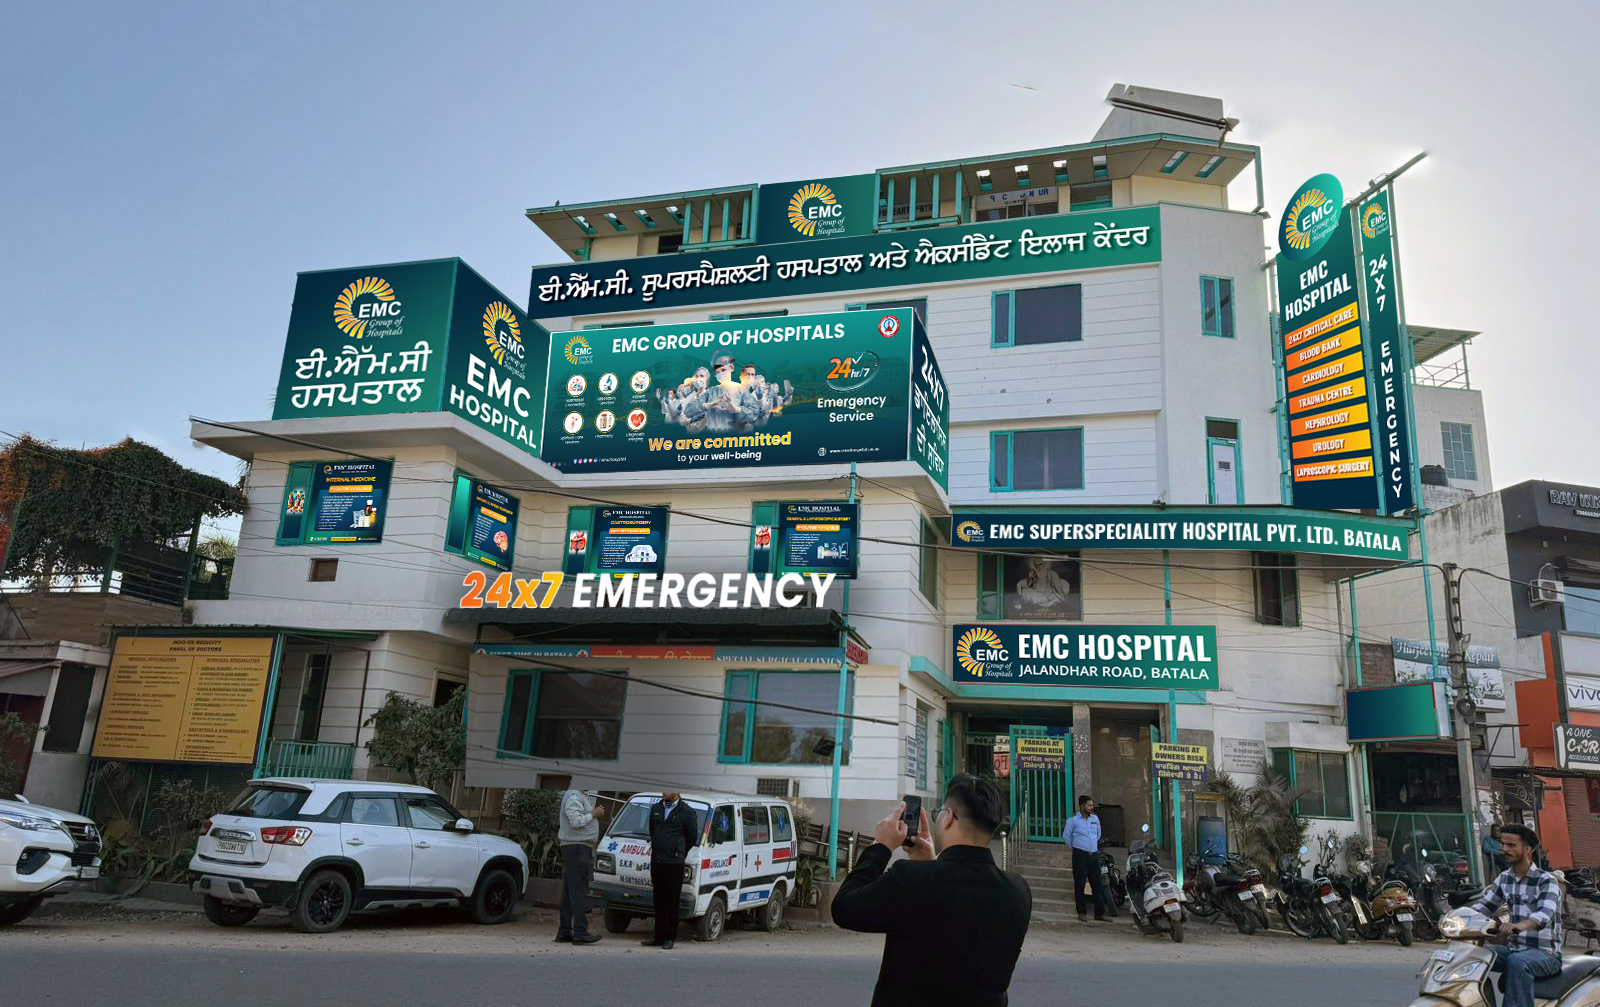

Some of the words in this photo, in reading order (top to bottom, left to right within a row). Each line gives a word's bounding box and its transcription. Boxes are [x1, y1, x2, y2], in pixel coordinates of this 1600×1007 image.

[808, 204, 842, 220] EMC
[1302, 199, 1334, 232] EMC
[1370, 212, 1386, 228] EMC
[776, 252, 863, 280] ਹਸਪਤਾਲ
[869, 242, 909, 270] ਅਤੇ
[914, 232, 1012, 265] ਐਕਸੀਡੈਂਟ
[1018, 229, 1086, 256] ਇਲਾਜ
[1093, 222, 1150, 248] ਕੇਂਦਰ
[1300, 260, 1328, 290] EMC
[1285, 273, 1351, 321] HOSPITAL
[358, 300, 402, 318] EMC
[366, 326, 404, 338] Hospitals
[369, 318, 392, 328] Group
[1288, 330, 1304, 346] 24X7
[1304, 318, 1333, 338] CRITICAL
[1334, 308, 1354, 325] CARE
[499, 330, 526, 360] EMC
[612, 336, 650, 354] EMC
[654, 332, 716, 350] GROUP
[718, 330, 742, 346] OF
[746, 323, 846, 345] HOSPITALS
[574, 346, 592, 356] EMC
[1300, 345, 1321, 362] BLOOD
[1322, 338, 1341, 353] BANK
[921, 344, 944, 412] 24X7
[1302, 362, 1344, 384] CARDIOLOGY
[291, 378, 426, 408] ਹਸਪਤਾਲ
[467, 353, 532, 418] EMC
[817, 396, 887, 410] Emergency
[1298, 394, 1326, 408] TRAUMA
[1326, 386, 1354, 401] CENTRE
[450, 384, 537, 450] HOSPITAL
[829, 410, 874, 423] Service
[1305, 412, 1350, 430] NEPHROLOGY
[1380, 340, 1402, 498] EMERGENCY
[649, 438, 674, 452] We
[675, 439, 701, 452] are
[704, 431, 792, 450] committed
[1312, 438, 1345, 453] UROLOGY
[677, 453, 686, 462] to
[688, 453, 710, 465] your
[711, 449, 762, 464] well-being
[1296, 463, 1338, 477] LAPROSCOPIC
[1338, 461, 1370, 473] SURGERY
[990, 524, 1024, 540] EMC
[1029, 523, 1177, 541] SUPERSPECIALITY
[1182, 522, 1262, 542] HOSPITAL
[1266, 524, 1301, 542] PVT.
[1306, 526, 1339, 546] LTD.
[1344, 529, 1402, 552] BATALA
[460, 570, 564, 609] 24x7
[572, 572, 837, 608] EMERGENCY
[976, 649, 1010, 662] EMC
[1018, 634, 1070, 660] EMC
[1078, 634, 1212, 662] HOSPITAL
[984, 670, 1014, 678] Hospitals
[986, 662, 1004, 670] Group
[1018, 664, 1098, 678] JALANDHAR
[1102, 666, 1148, 680] ROAD,
[1152, 666, 1210, 680] BATALA
[1573, 728, 1593, 738] ONE
[1155, 752, 1186, 761] OWNERS
[1159, 745, 1190, 753] PARKING
[619, 844, 652, 856] AMBULA
